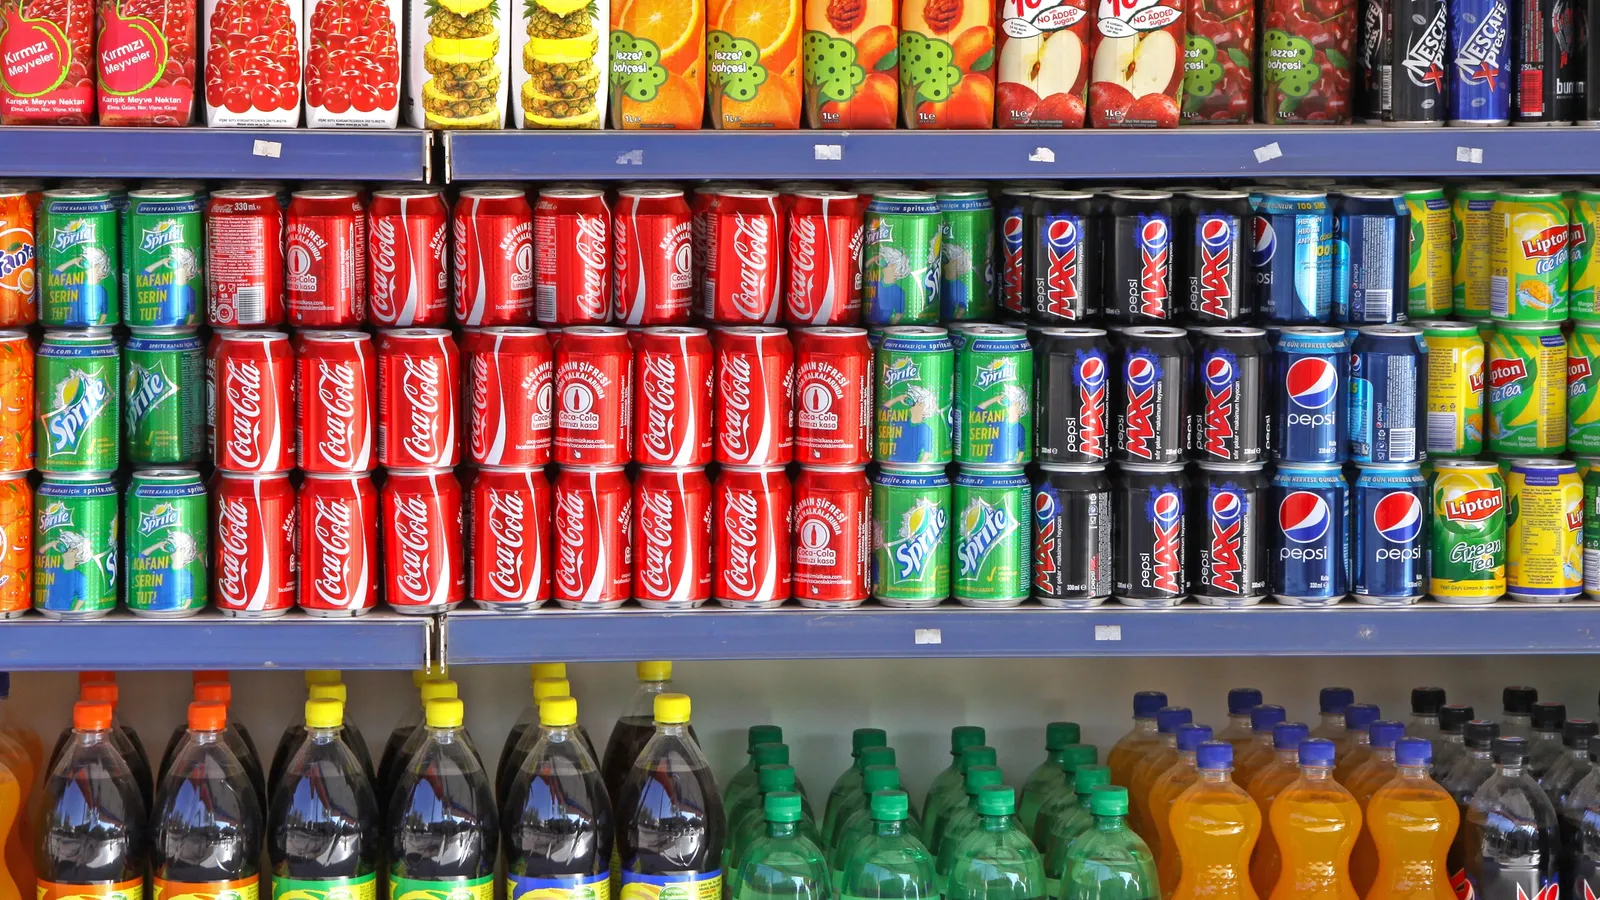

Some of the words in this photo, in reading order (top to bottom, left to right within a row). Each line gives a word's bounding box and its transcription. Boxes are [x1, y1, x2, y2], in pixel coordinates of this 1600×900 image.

[1037, 15, 1052, 24] NO
[1052, 9, 1078, 20] ADDED
[1053, 17, 1075, 26] sugars
[1133, 15, 1148, 24] NO
[1148, 9, 1174, 20] ADDED
[1149, 17, 1171, 26] sugars
[615, 50, 644, 60] lezzet
[714, 50, 743, 60] lezzet
[1270, 47, 1298, 58] lezzet
[8, 53, 54, 76] Meyveler
[105, 50, 151, 75] Meyveler
[613, 63, 647, 74] bahçesi
[712, 63, 747, 74] bahçesi
[1267, 60, 1301, 72] bahçesi
[234, 202, 248, 210] 330
[1036, 278, 1047, 312] pepsi
[1047, 242, 1078, 321] MAX
[1128, 279, 1139, 314] pepsi
[1140, 242, 1169, 320] MAX
[1189, 276, 1200, 311] pepsi
[1201, 241, 1232, 319] MAX
[51, 307, 73, 320] TUT!
[139, 307, 162, 321] TUT!
[885, 367, 917, 384] Sprite
[1079, 382, 1104, 460] MAX
[1126, 381, 1155, 460] MAX
[1205, 382, 1233, 460] MAX
[1287, 412, 1335, 428] pepsi
[1066, 416, 1077, 452] pepsi
[971, 443, 994, 457] TUT!
[1451, 495, 1501, 516] Lipton
[40, 511, 69, 528] Sprite
[142, 513, 176, 531] Sprite
[896, 507, 946, 578] Sprite
[958, 507, 1004, 577] Sprite
[1140, 553, 1151, 588] pepsi
[1153, 517, 1180, 594] MAX
[1201, 550, 1210, 585] pepsi
[1212, 515, 1242, 594] MAX
[1280, 546, 1327, 562] pepsi
[1376, 546, 1421, 562] pepsi
[1451, 540, 1501, 563] Green
[1470, 555, 1495, 572] Tea
[136, 591, 157, 604] TUT!
